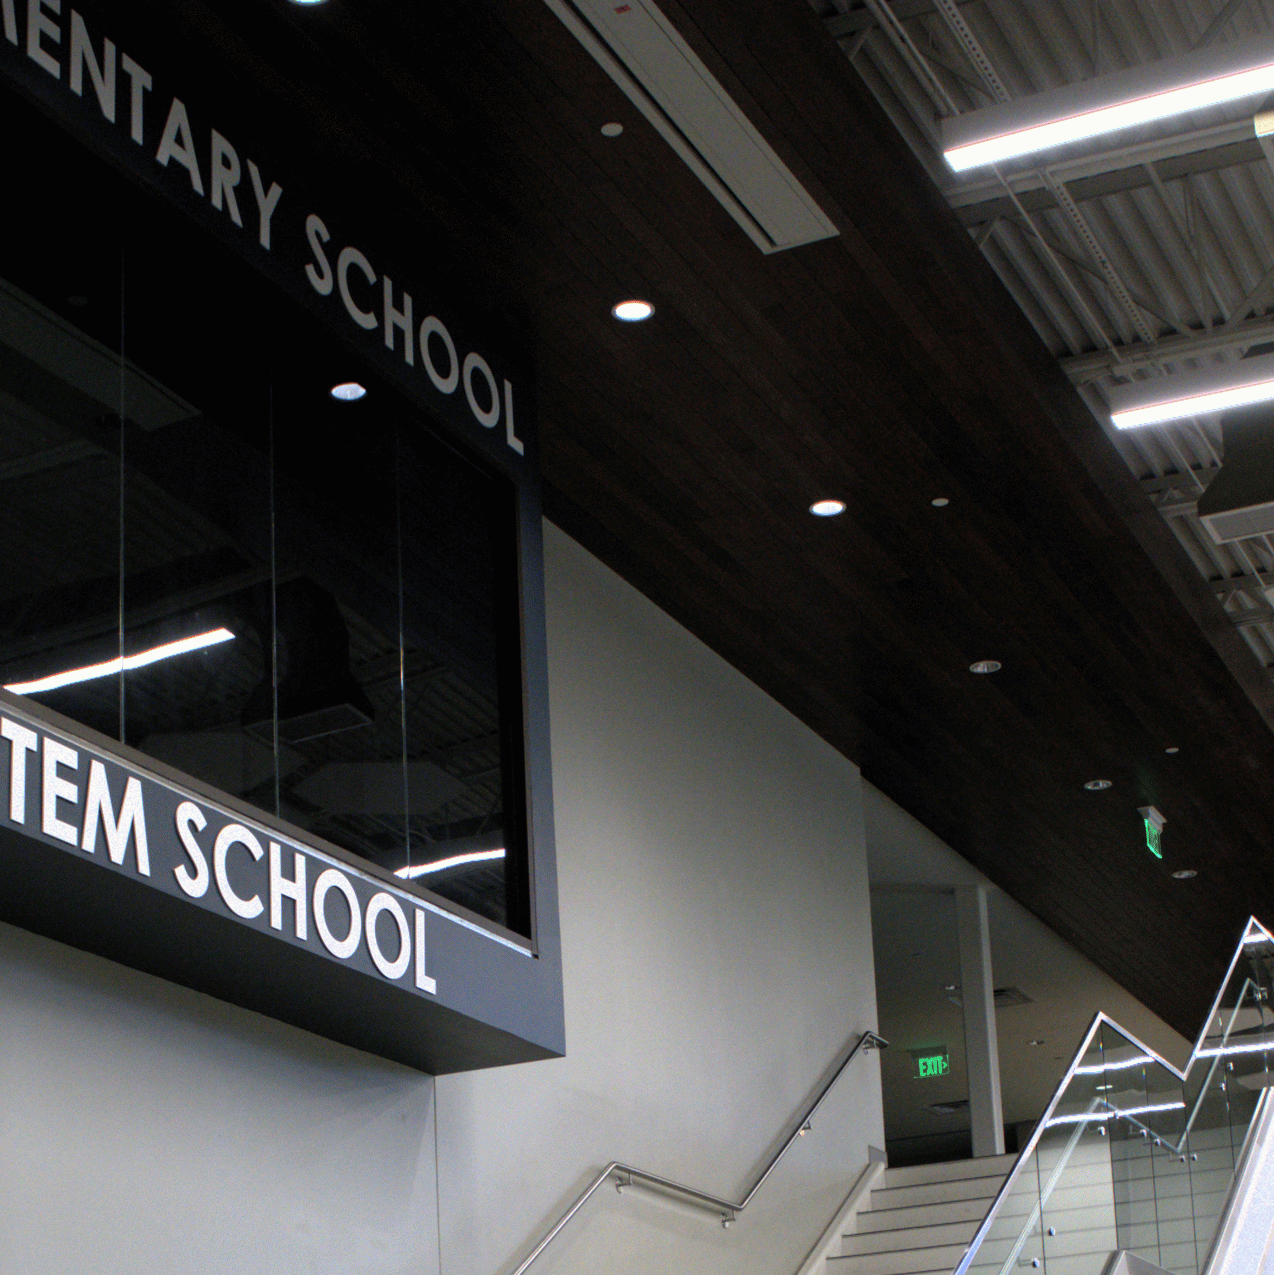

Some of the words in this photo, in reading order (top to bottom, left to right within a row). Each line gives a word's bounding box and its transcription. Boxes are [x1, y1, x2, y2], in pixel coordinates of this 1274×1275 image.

[305, 212, 525, 456] SCHOOL
[174, 801, 437, 995] SCHOOL
[918, 1055, 943, 1077] EXIT
